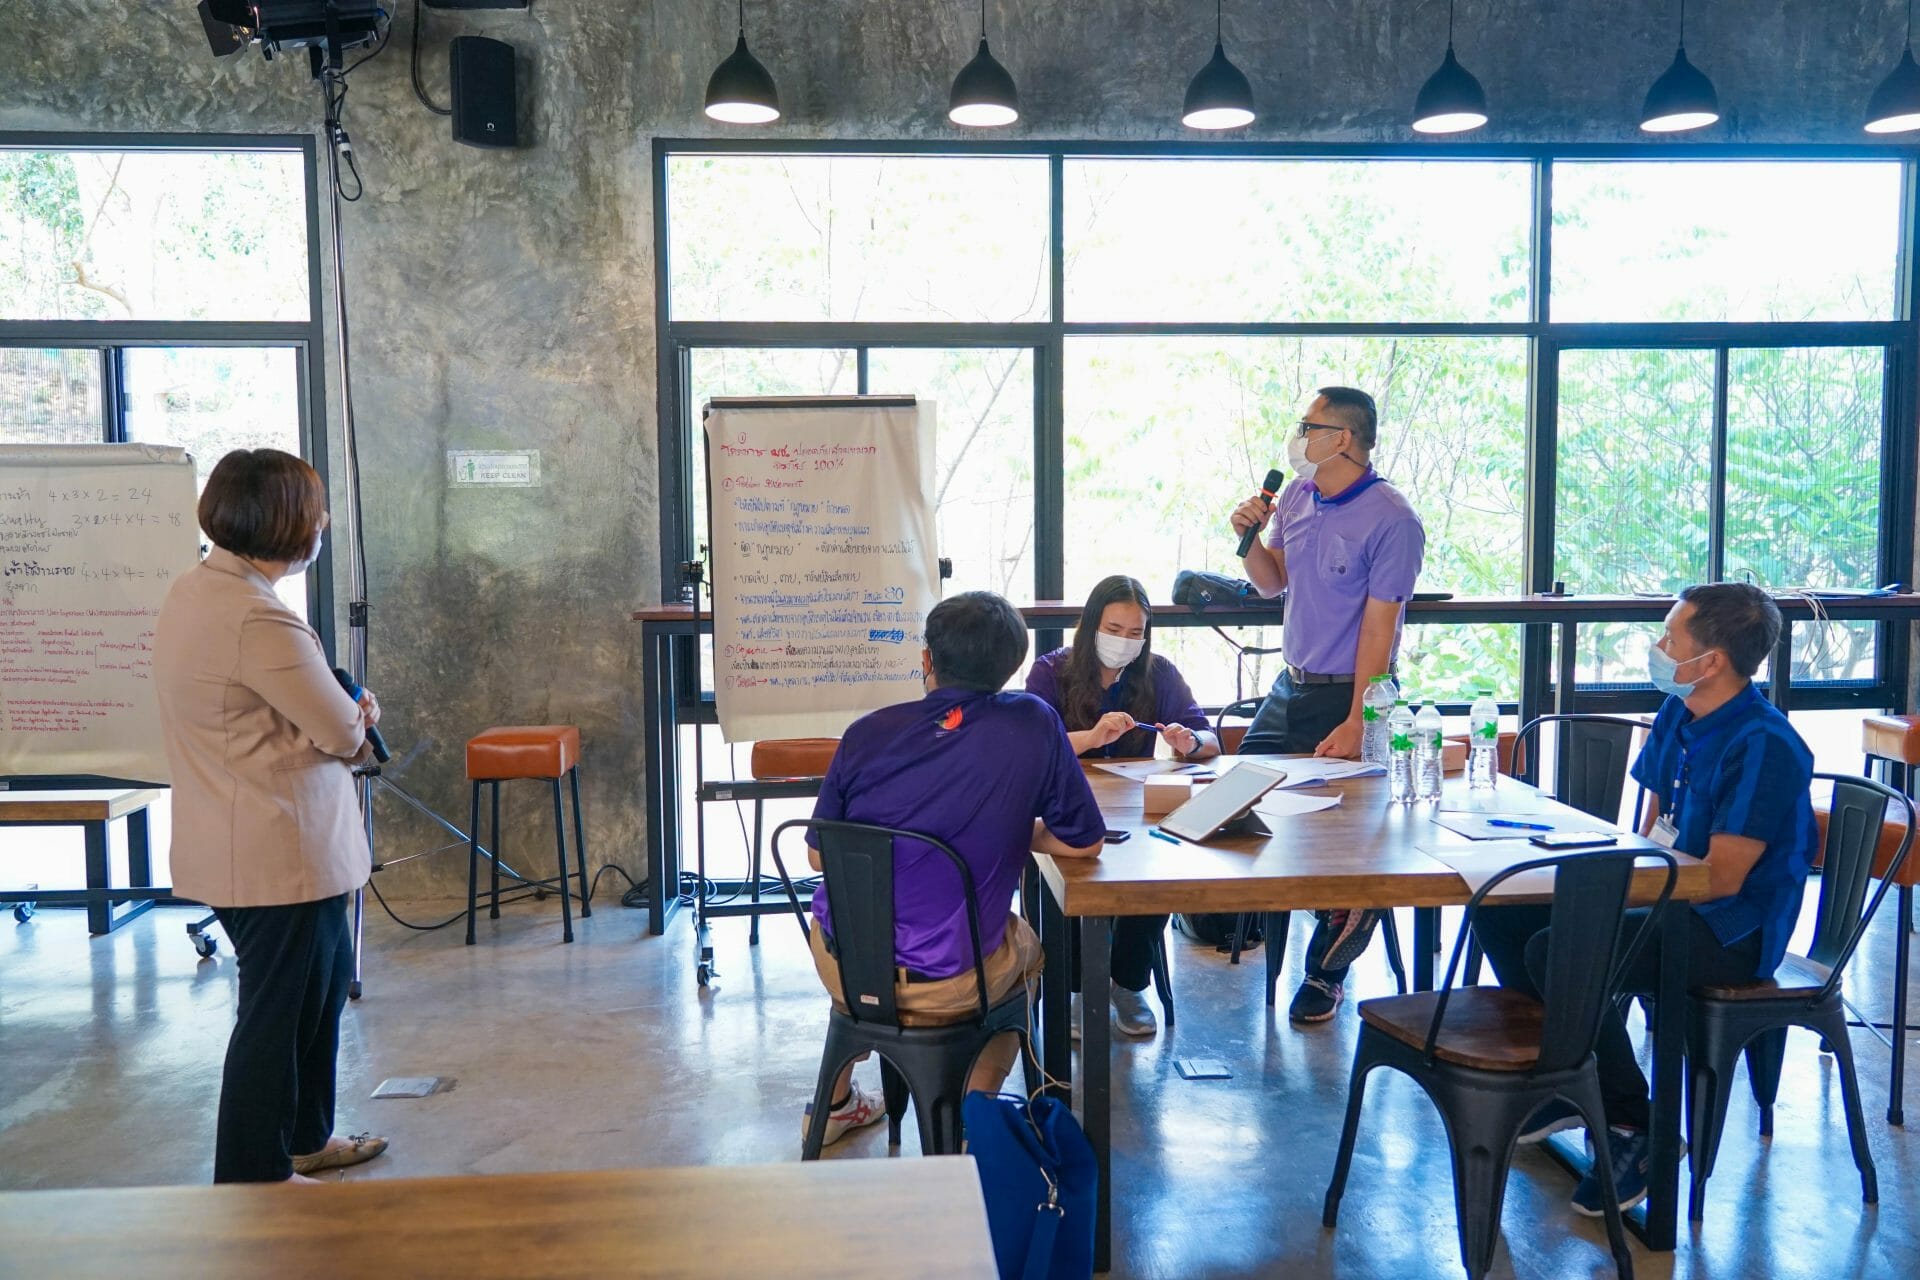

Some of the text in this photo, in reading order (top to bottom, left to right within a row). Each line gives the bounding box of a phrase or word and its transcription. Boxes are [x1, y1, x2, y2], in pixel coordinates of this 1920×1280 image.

[49, 488, 57, 502] 4
[72, 490, 80, 499] 3
[96, 488, 108, 501] 2
[128, 487, 152, 504] 24
[72, 514, 83, 529] 3
[110, 512, 121, 526] 4
[136, 512, 147, 526] 4
[168, 511, 185, 527] 48
[101, 568, 110, 581] 4
[123, 567, 136, 582] 4
